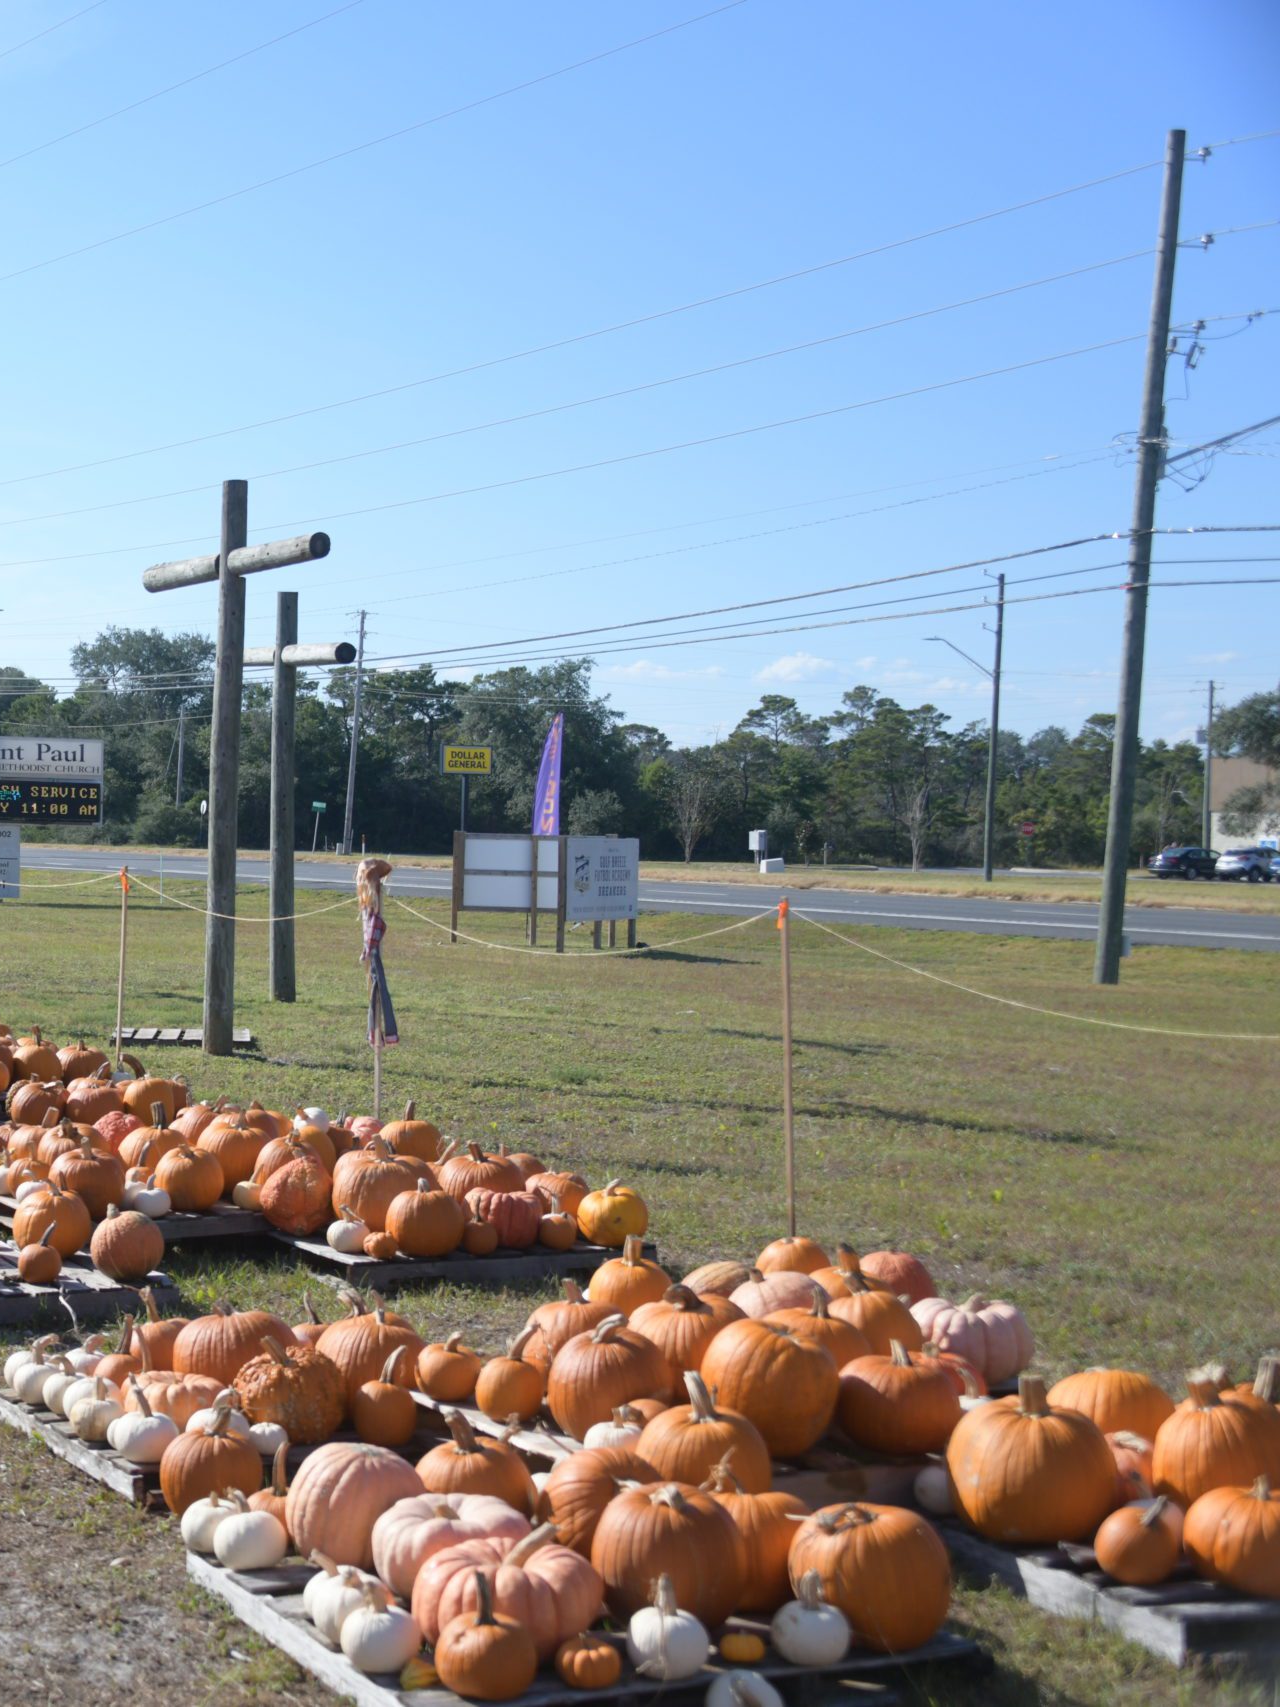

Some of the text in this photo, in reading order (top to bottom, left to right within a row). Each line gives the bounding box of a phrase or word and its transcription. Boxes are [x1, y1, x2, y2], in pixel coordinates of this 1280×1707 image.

[36, 743, 86, 762] Paul
[450, 751, 485, 759] DOLLAR
[448, 760, 487, 768] GENERAL
[55, 765, 100, 774] CHURCH
[30, 786, 97, 799] SERVICE
[22, 803, 68, 815] 11:00
[79, 805, 97, 815] AM
